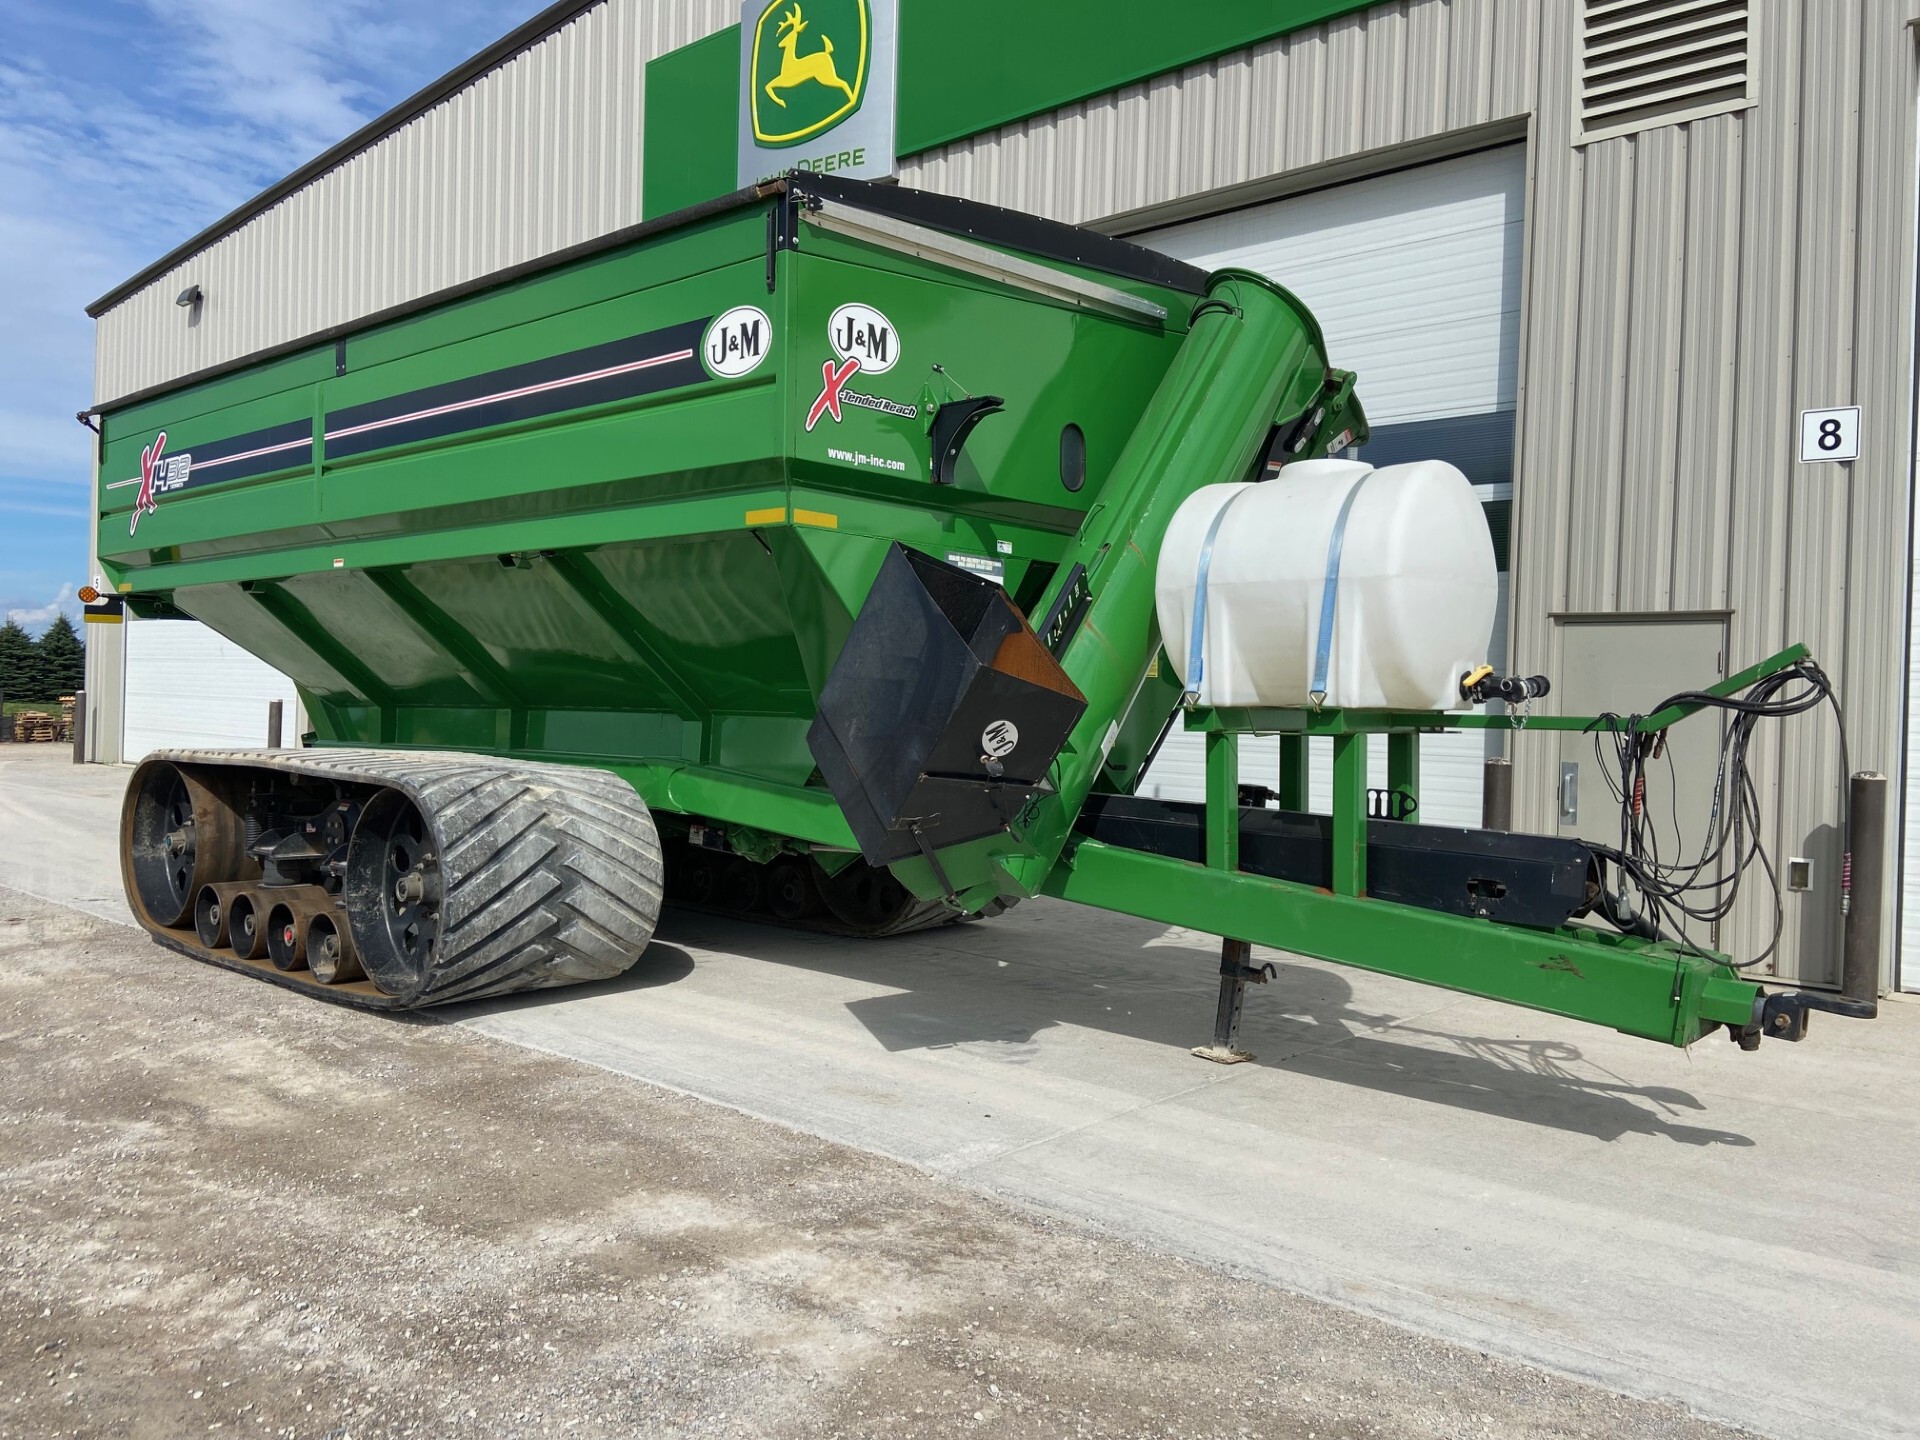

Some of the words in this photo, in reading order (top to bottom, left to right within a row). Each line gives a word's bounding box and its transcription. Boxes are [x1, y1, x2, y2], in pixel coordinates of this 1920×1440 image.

[797, 148, 865, 173] DEERE
[712, 319, 761, 364] J&M
[836, 317, 888, 362] J&M
[882, 399, 916, 418] Reach
[1818, 418, 1842, 451] 8
[828, 448, 905, 471] www.jm-inc.com
[985, 722, 1015, 752] J&M
